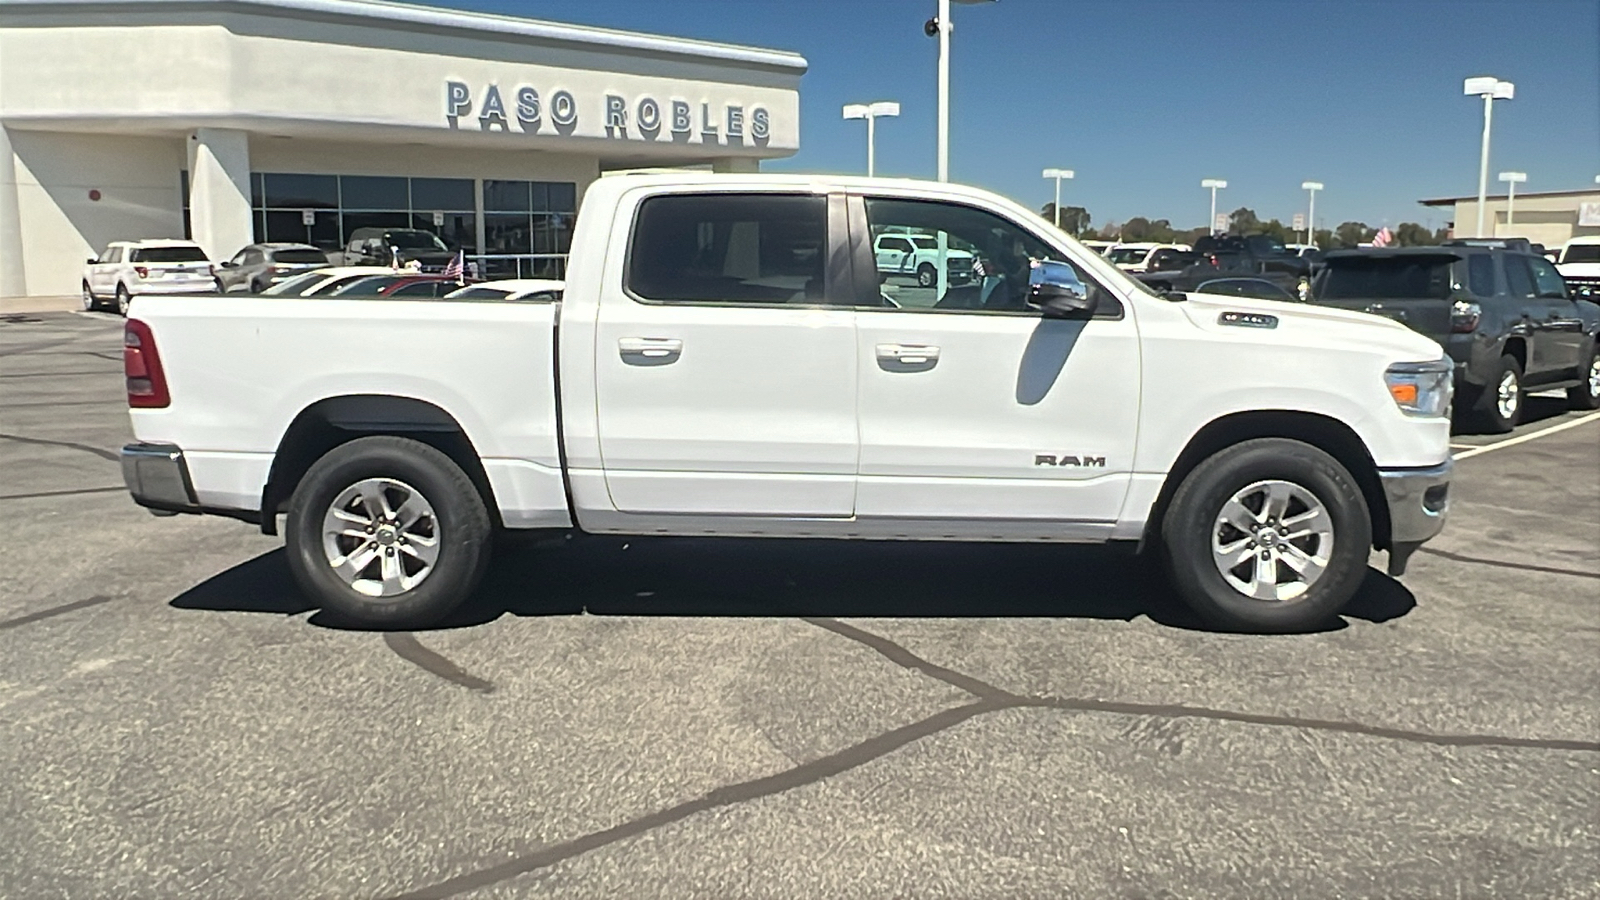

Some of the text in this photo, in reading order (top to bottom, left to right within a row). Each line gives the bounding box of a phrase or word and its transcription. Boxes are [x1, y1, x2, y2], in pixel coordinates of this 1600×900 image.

[446, 81, 771, 139] PASO ROBLES
[1035, 455, 1106, 467] RAM
